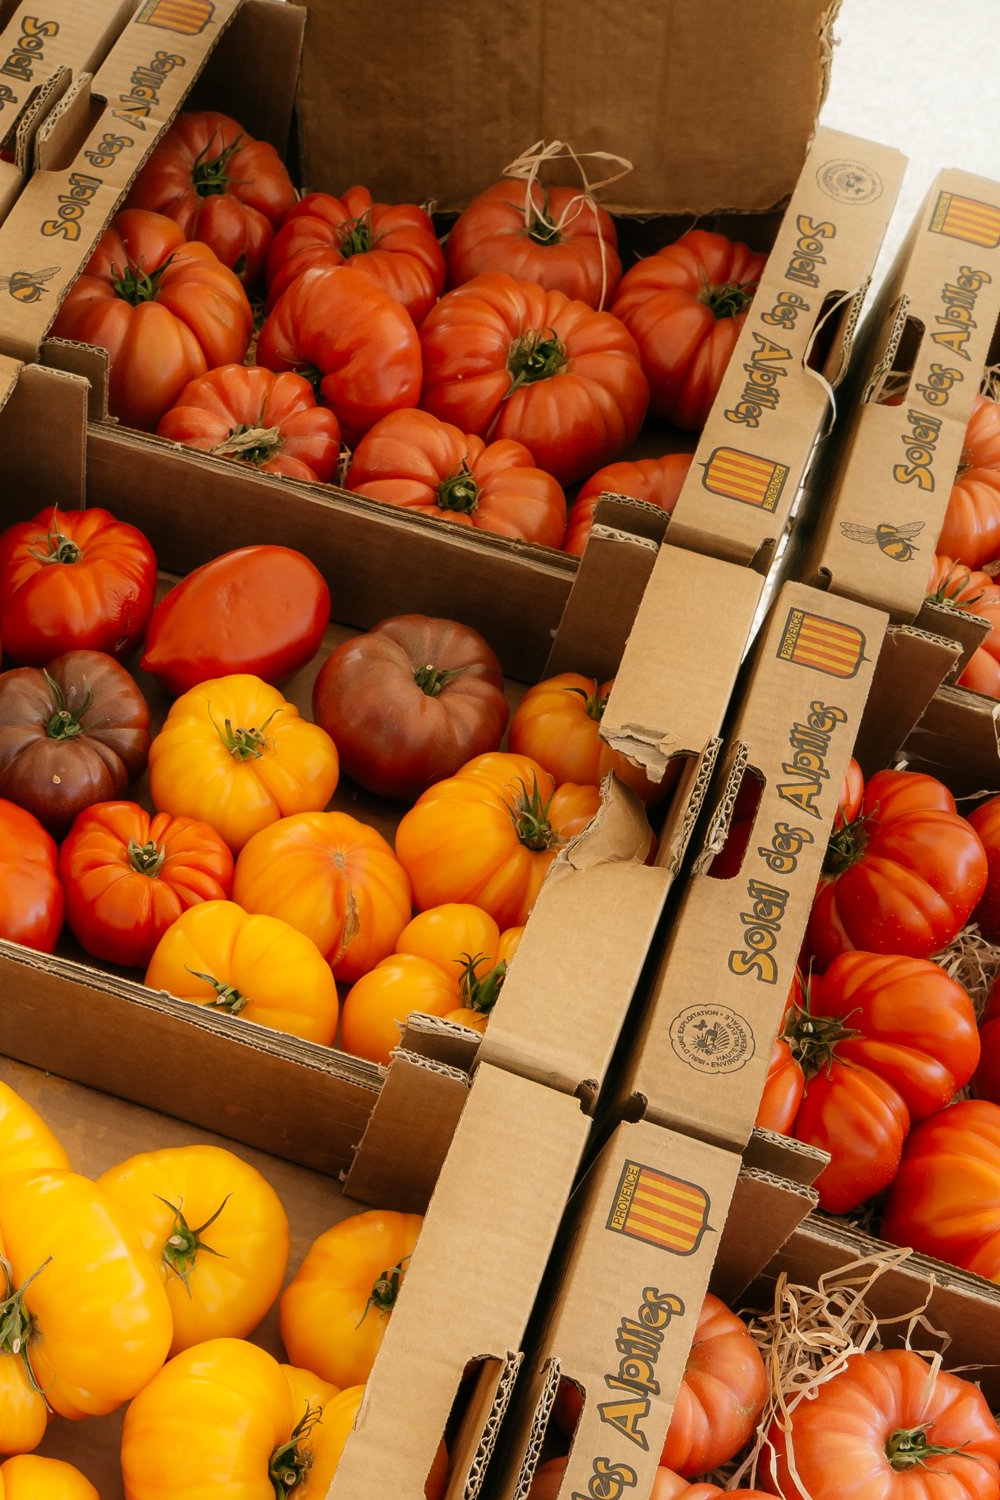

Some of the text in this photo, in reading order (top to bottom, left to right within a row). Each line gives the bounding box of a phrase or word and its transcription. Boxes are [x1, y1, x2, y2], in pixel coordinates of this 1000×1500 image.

[0, 15, 60, 82] Soleil
[40, 51, 186, 241] Soleil des Alpilles
[724, 214, 836, 428] Soleil des Alpilles
[893, 265, 992, 492] Soleil des Alpilles
[763, 467, 785, 509] PROVENCE
[781, 612, 802, 656] PROVENCE
[728, 700, 848, 985] Soleil des Alpilles
[677, 1009, 719, 1035] EXPLOITATION
[716, 1047, 738, 1062] HAUTE
[613, 1167, 639, 1226] PROVENCE
[597, 1286, 685, 1452] Alpilles
